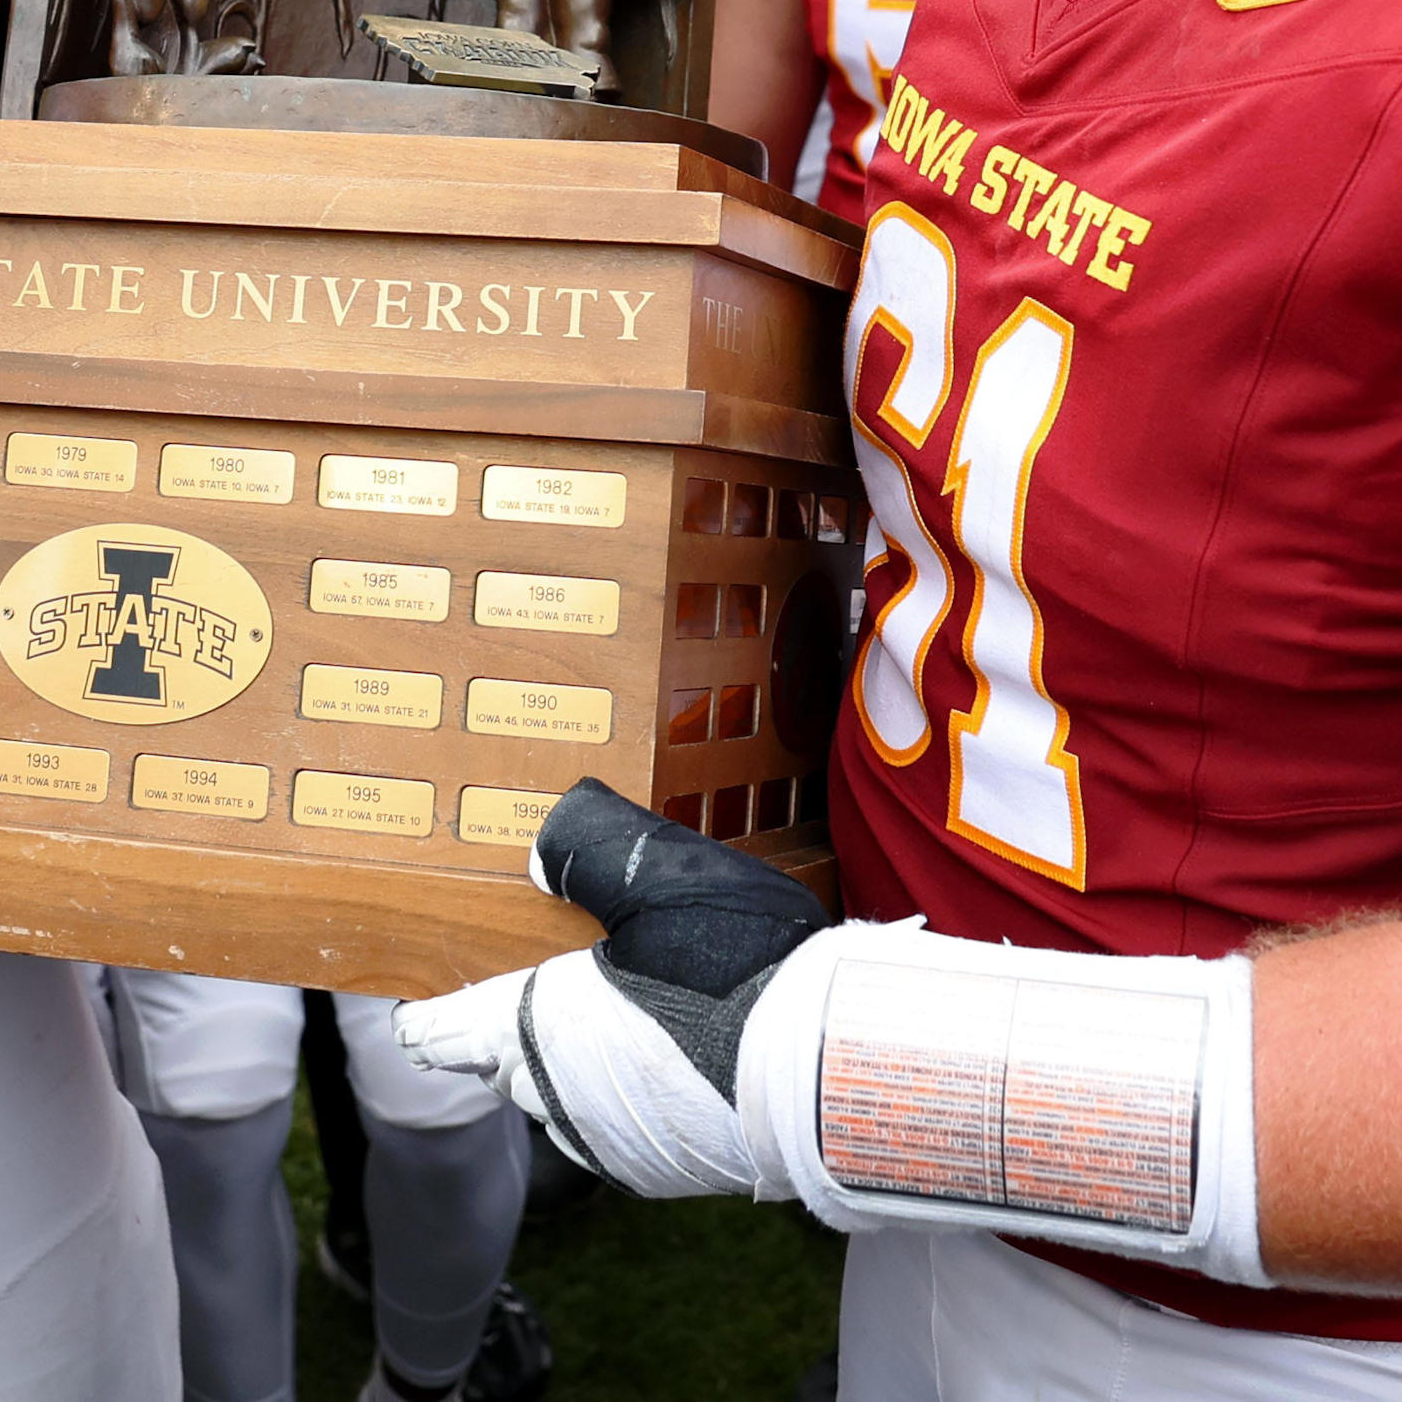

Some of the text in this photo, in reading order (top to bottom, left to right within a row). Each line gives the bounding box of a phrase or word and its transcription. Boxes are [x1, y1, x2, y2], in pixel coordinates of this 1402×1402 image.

[879, 74, 1153, 293] IOWA STATE
[179, 268, 658, 345] UNIVERSITY
[56, 446, 86, 461] 1979
[210, 457, 244, 473] 1980
[15, 466, 37, 475] IOWA
[57, 470, 80, 479] IOWA
[84, 471, 110, 481] STATE
[115, 474, 124, 482] 14
[372, 469, 405, 485] 1981
[172, 478, 195, 487] IOWA
[200, 480, 227, 490] STATE
[246, 483, 270, 493] IOWA
[536, 479, 572, 496] 1982
[326, 491, 352, 501] IOWA
[355, 492, 385, 503] STATE
[408, 495, 433, 505] IOWA
[437, 498, 446, 507] 12
[496, 501, 521, 510] IOWA
[526, 503, 554, 513] STATE
[574, 506, 600, 516] IOWA
[605, 508, 610, 516] 7
[842, 200, 1088, 893] 61
[363, 573, 398, 590] 1985
[323, 594, 347, 603] IOWA
[366, 597, 391, 607] IOWA
[395, 599, 424, 610] STATE
[529, 586, 565, 603] 1986
[487, 607, 512, 617] IOWA
[534, 610, 559, 621] IOWA
[563, 613, 594, 624] STATE
[599, 615, 604, 624] 7
[26, 591, 237, 680] STATE
[354, 679, 389, 696] 1989
[313, 699, 337, 710] IOWA
[356, 703, 380, 714] IOWA
[385, 706, 414, 717] STATE
[418, 709, 428, 718] 21
[520, 693, 557, 711] 1990
[476, 714, 500, 724] IOWA
[522, 718, 548, 729] IOWA
[552, 720, 583, 732] STATE
[587, 723, 599, 733] 35
[26, 753, 60, 770] 1993
[26, 776, 49, 788] IOWA
[54, 779, 82, 791] STATE
[86, 782, 97, 792] 28
[184, 770, 218, 786] 1994
[145, 789, 168, 800] IOWA
[187, 794, 210, 805] IOWA
[215, 796, 243, 808] STATE
[248, 800, 254, 809] 9
[346, 786, 381, 802] 1995
[304, 806, 328, 816] IOWA
[347, 810, 372, 821] IOWA
[376, 813, 405, 824] STATE
[410, 816, 420, 826] 10
[512, 802, 550, 819] 1996
[468, 823, 492, 834] IOWA
